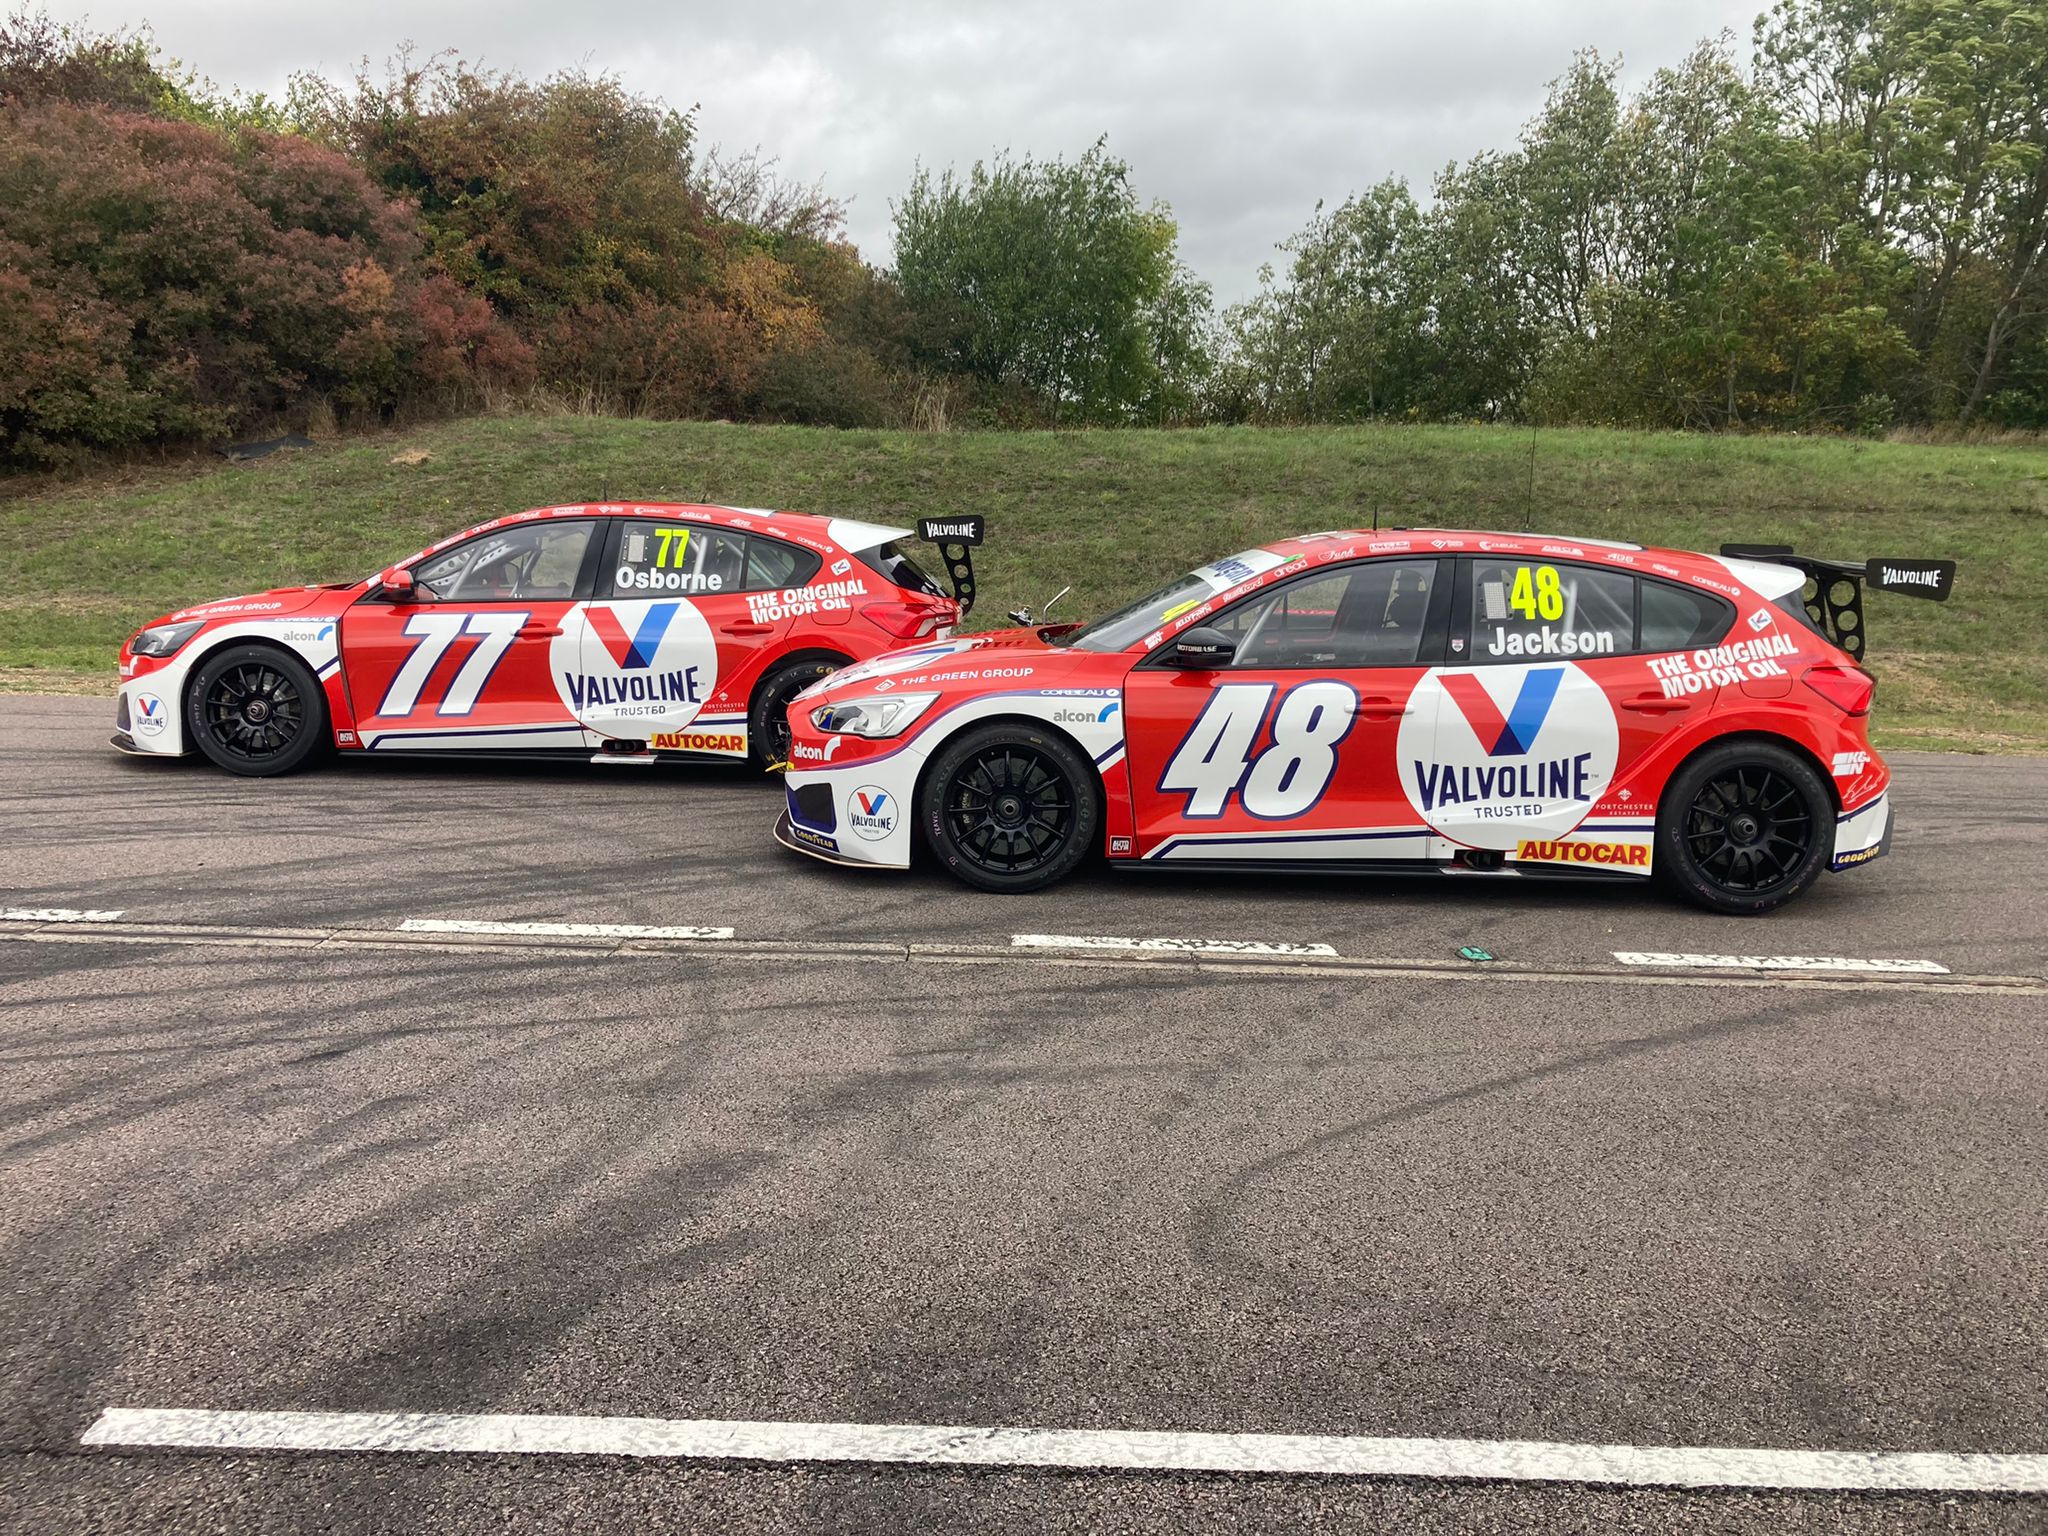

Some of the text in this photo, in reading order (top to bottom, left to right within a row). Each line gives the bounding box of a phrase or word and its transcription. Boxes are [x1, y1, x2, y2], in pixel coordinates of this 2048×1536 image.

[926, 521, 975, 538] VALVOLINE
[654, 528, 691, 569] 77
[615, 565, 723, 592] Osborne
[1274, 559, 1308, 577] dread
[1882, 566, 1942, 588] VALVOLINE
[745, 579, 868, 611] THE ORIGINAL
[1510, 566, 1563, 620] 48
[209, 605, 242, 614] GREEN
[244, 602, 282, 611] GROUP
[750, 598, 850, 625] MOTOR OIL
[283, 631, 316, 641] alcon
[1488, 626, 1614, 656] Jackson
[376, 611, 532, 718] 77
[1646, 634, 1799, 679] THE ORIGINAL
[564, 665, 701, 711] VALVOLINE
[902, 667, 1034, 686] THE GREEN GROUP
[1660, 659, 1788, 699] MOTOR OIL
[614, 704, 666, 717] TRUSTED
[1053, 708, 1096, 723] alcon
[652, 733, 743, 751] AUTOCAR
[794, 741, 823, 760] alcon
[1155, 678, 1361, 821] 48
[1414, 752, 1592, 812] VALVOLINE
[851, 812, 892, 831] VALVOLINE
[1474, 803, 1543, 818] TRUSTED
[797, 830, 834, 848] GOODYEAR
[1520, 841, 1647, 866] AUTOCAR
